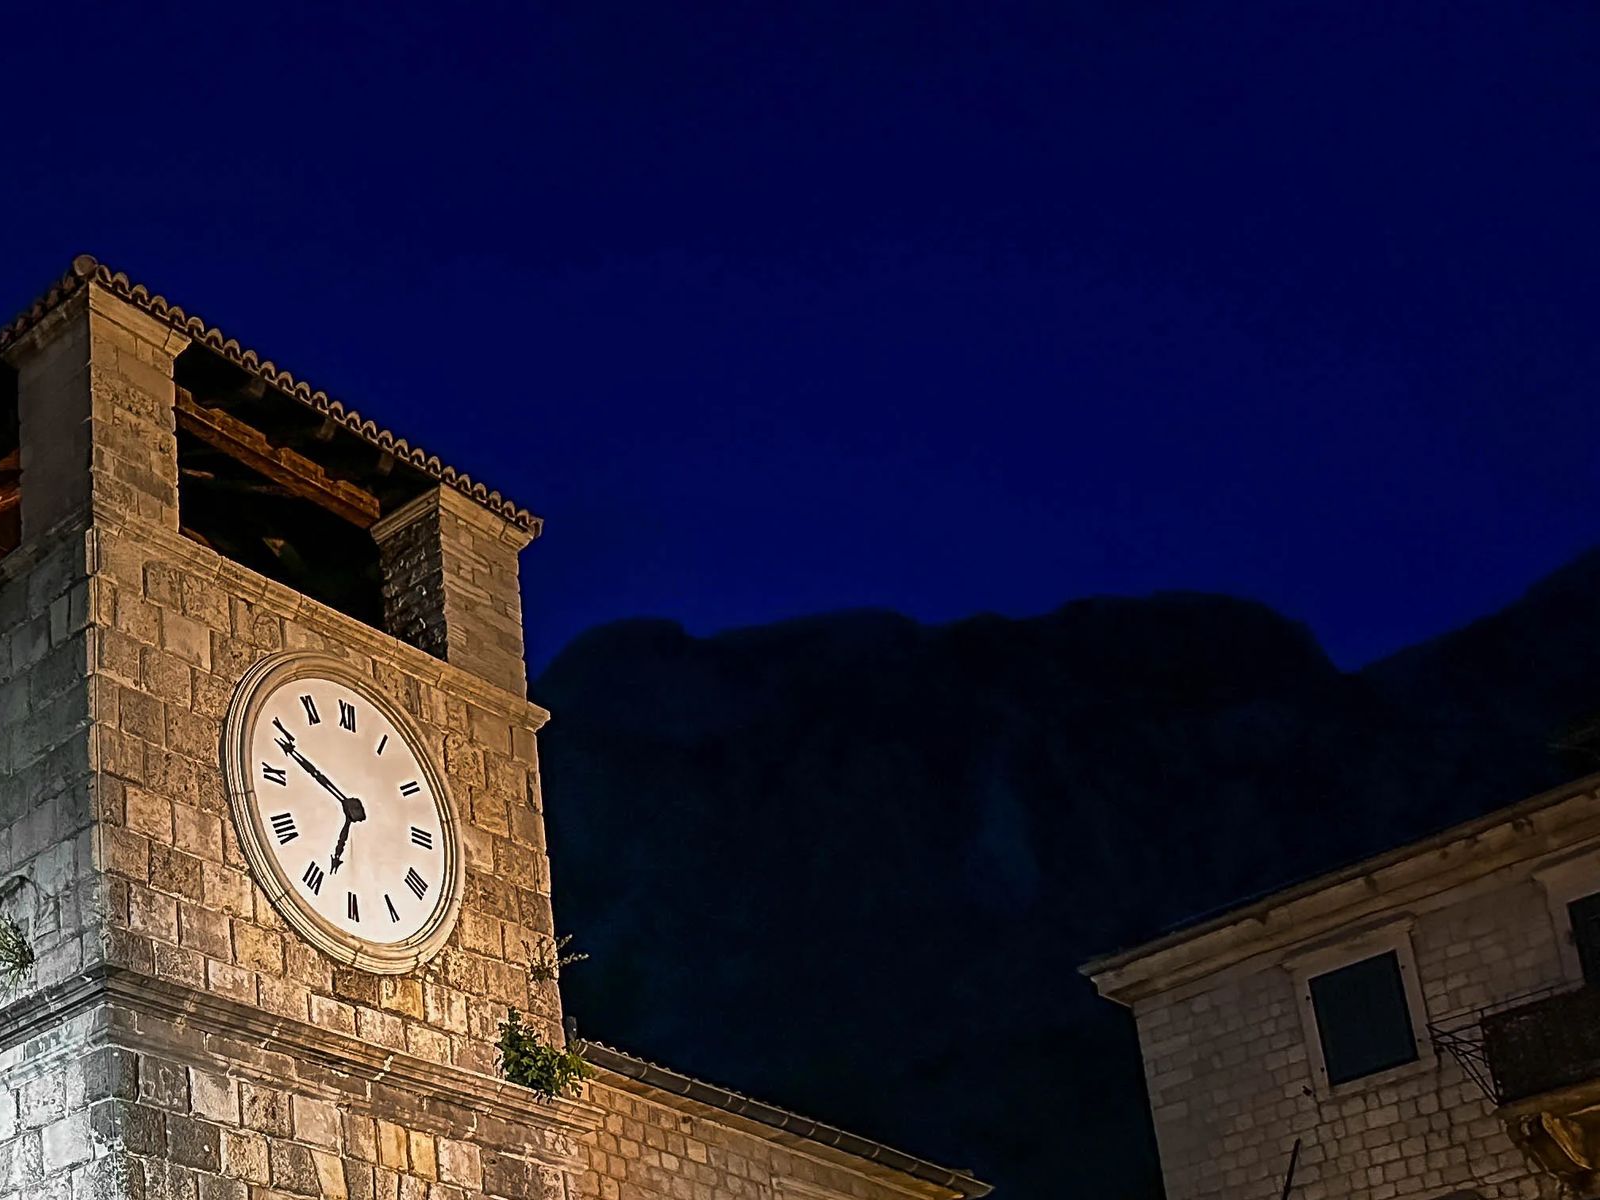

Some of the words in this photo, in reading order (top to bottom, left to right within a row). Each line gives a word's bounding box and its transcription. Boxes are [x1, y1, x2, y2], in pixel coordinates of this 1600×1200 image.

[300, 695, 321, 726] XI
[338, 699, 357, 733] XII
[377, 734, 389, 755] I
[262, 762, 287, 787] IX
[399, 780, 421, 797] II
[270, 812, 299, 845] VIII
[410, 826, 433, 850] III
[302, 860, 325, 896] VII
[404, 866, 429, 901] IIII
[348, 891, 360, 923] VI
[384, 893, 401, 924] V
